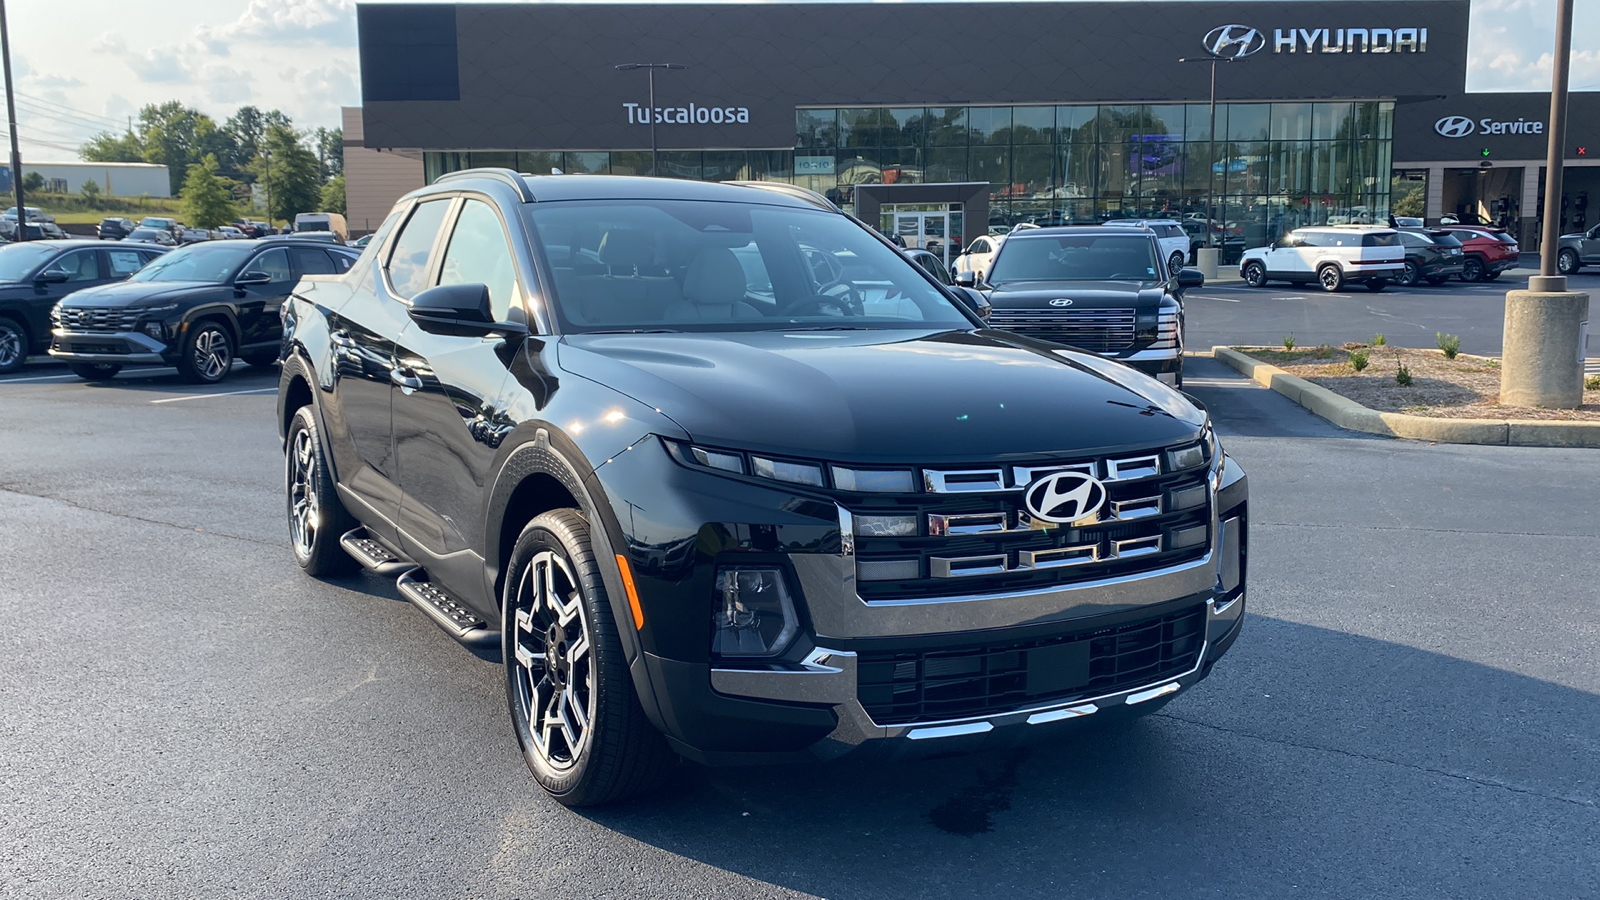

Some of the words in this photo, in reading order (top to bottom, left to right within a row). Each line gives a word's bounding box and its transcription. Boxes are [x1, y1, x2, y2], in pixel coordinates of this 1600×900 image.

[1273, 28, 1428, 54] HYUNDAI
[622, 102, 749, 124] Tuscaloosa
[1479, 118, 1543, 135] Service
